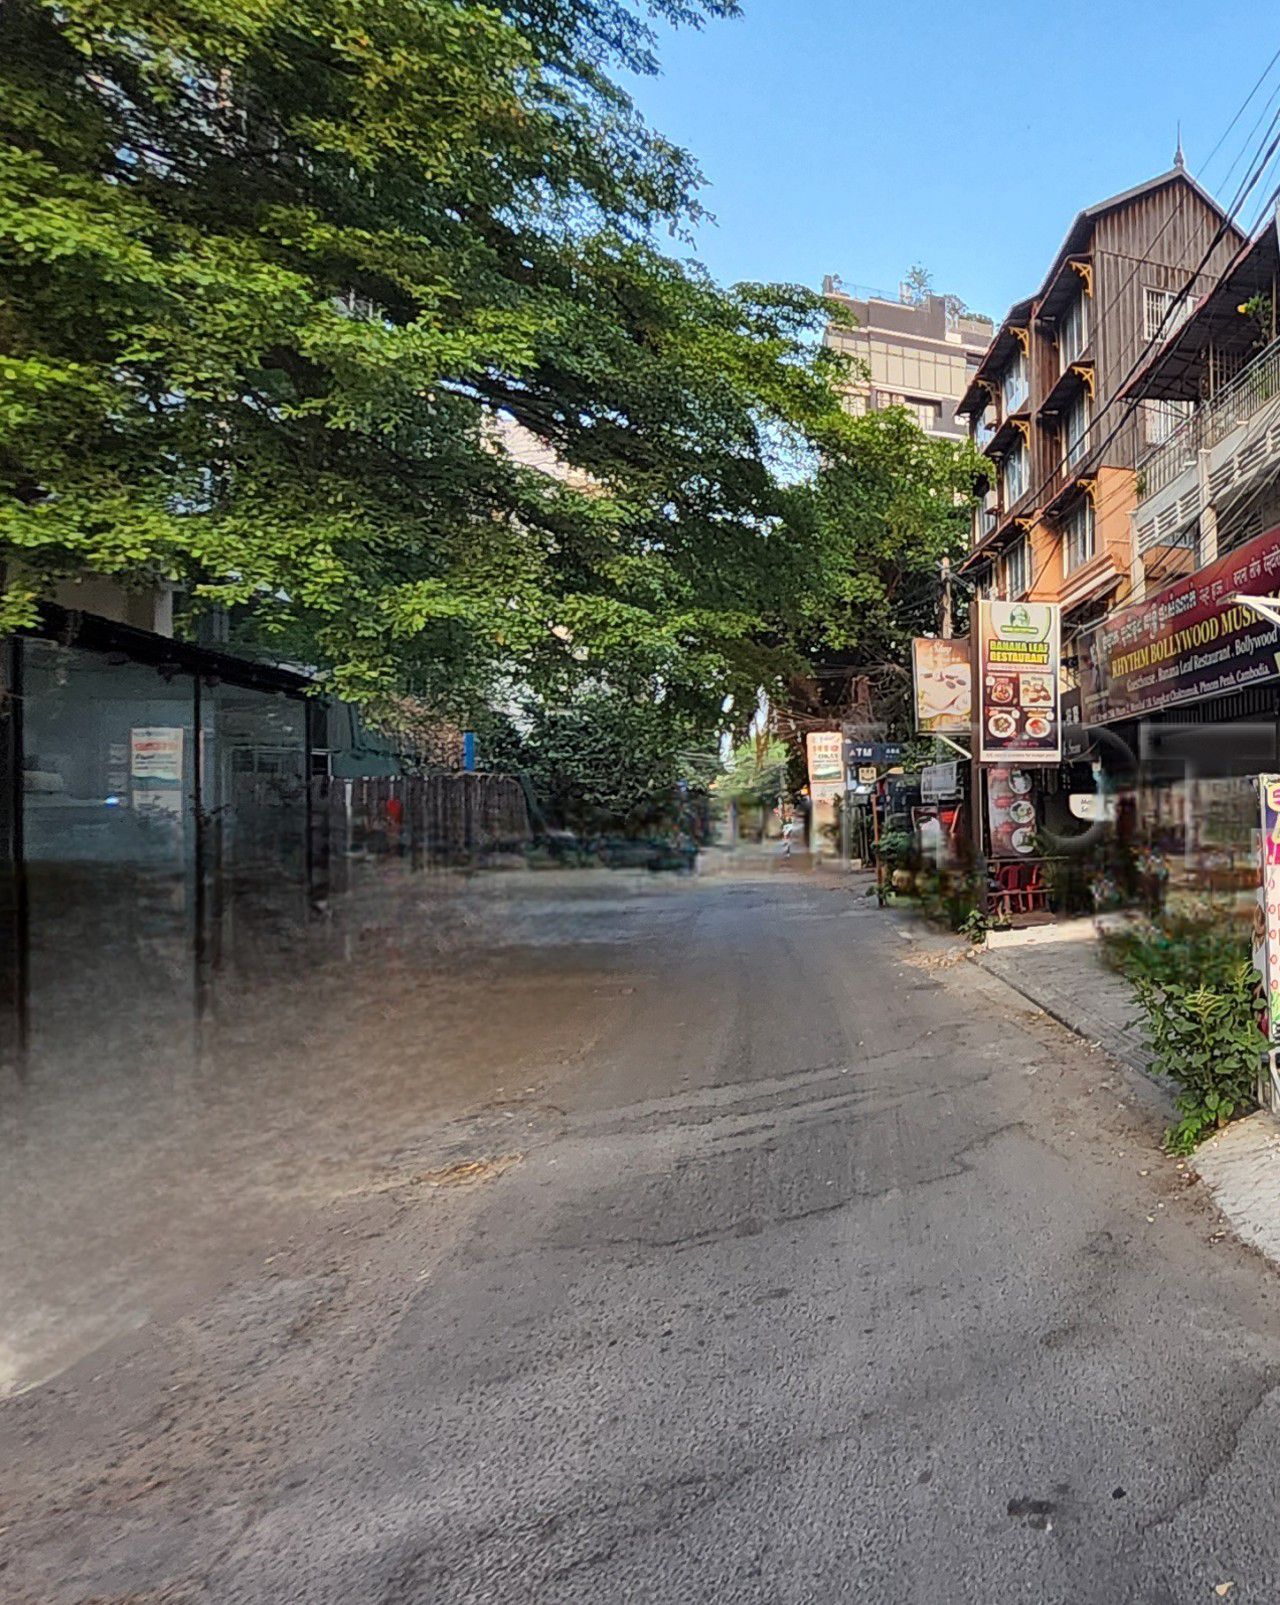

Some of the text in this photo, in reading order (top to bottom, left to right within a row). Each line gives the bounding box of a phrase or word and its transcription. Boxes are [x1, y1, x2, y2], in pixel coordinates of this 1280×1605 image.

[1111, 646, 1150, 679] RHYTHM
[1150, 609, 1219, 665] BOLLYWOOD
[1193, 644, 1231, 670] Restaurant
[1234, 624, 1278, 656] Bollywood
